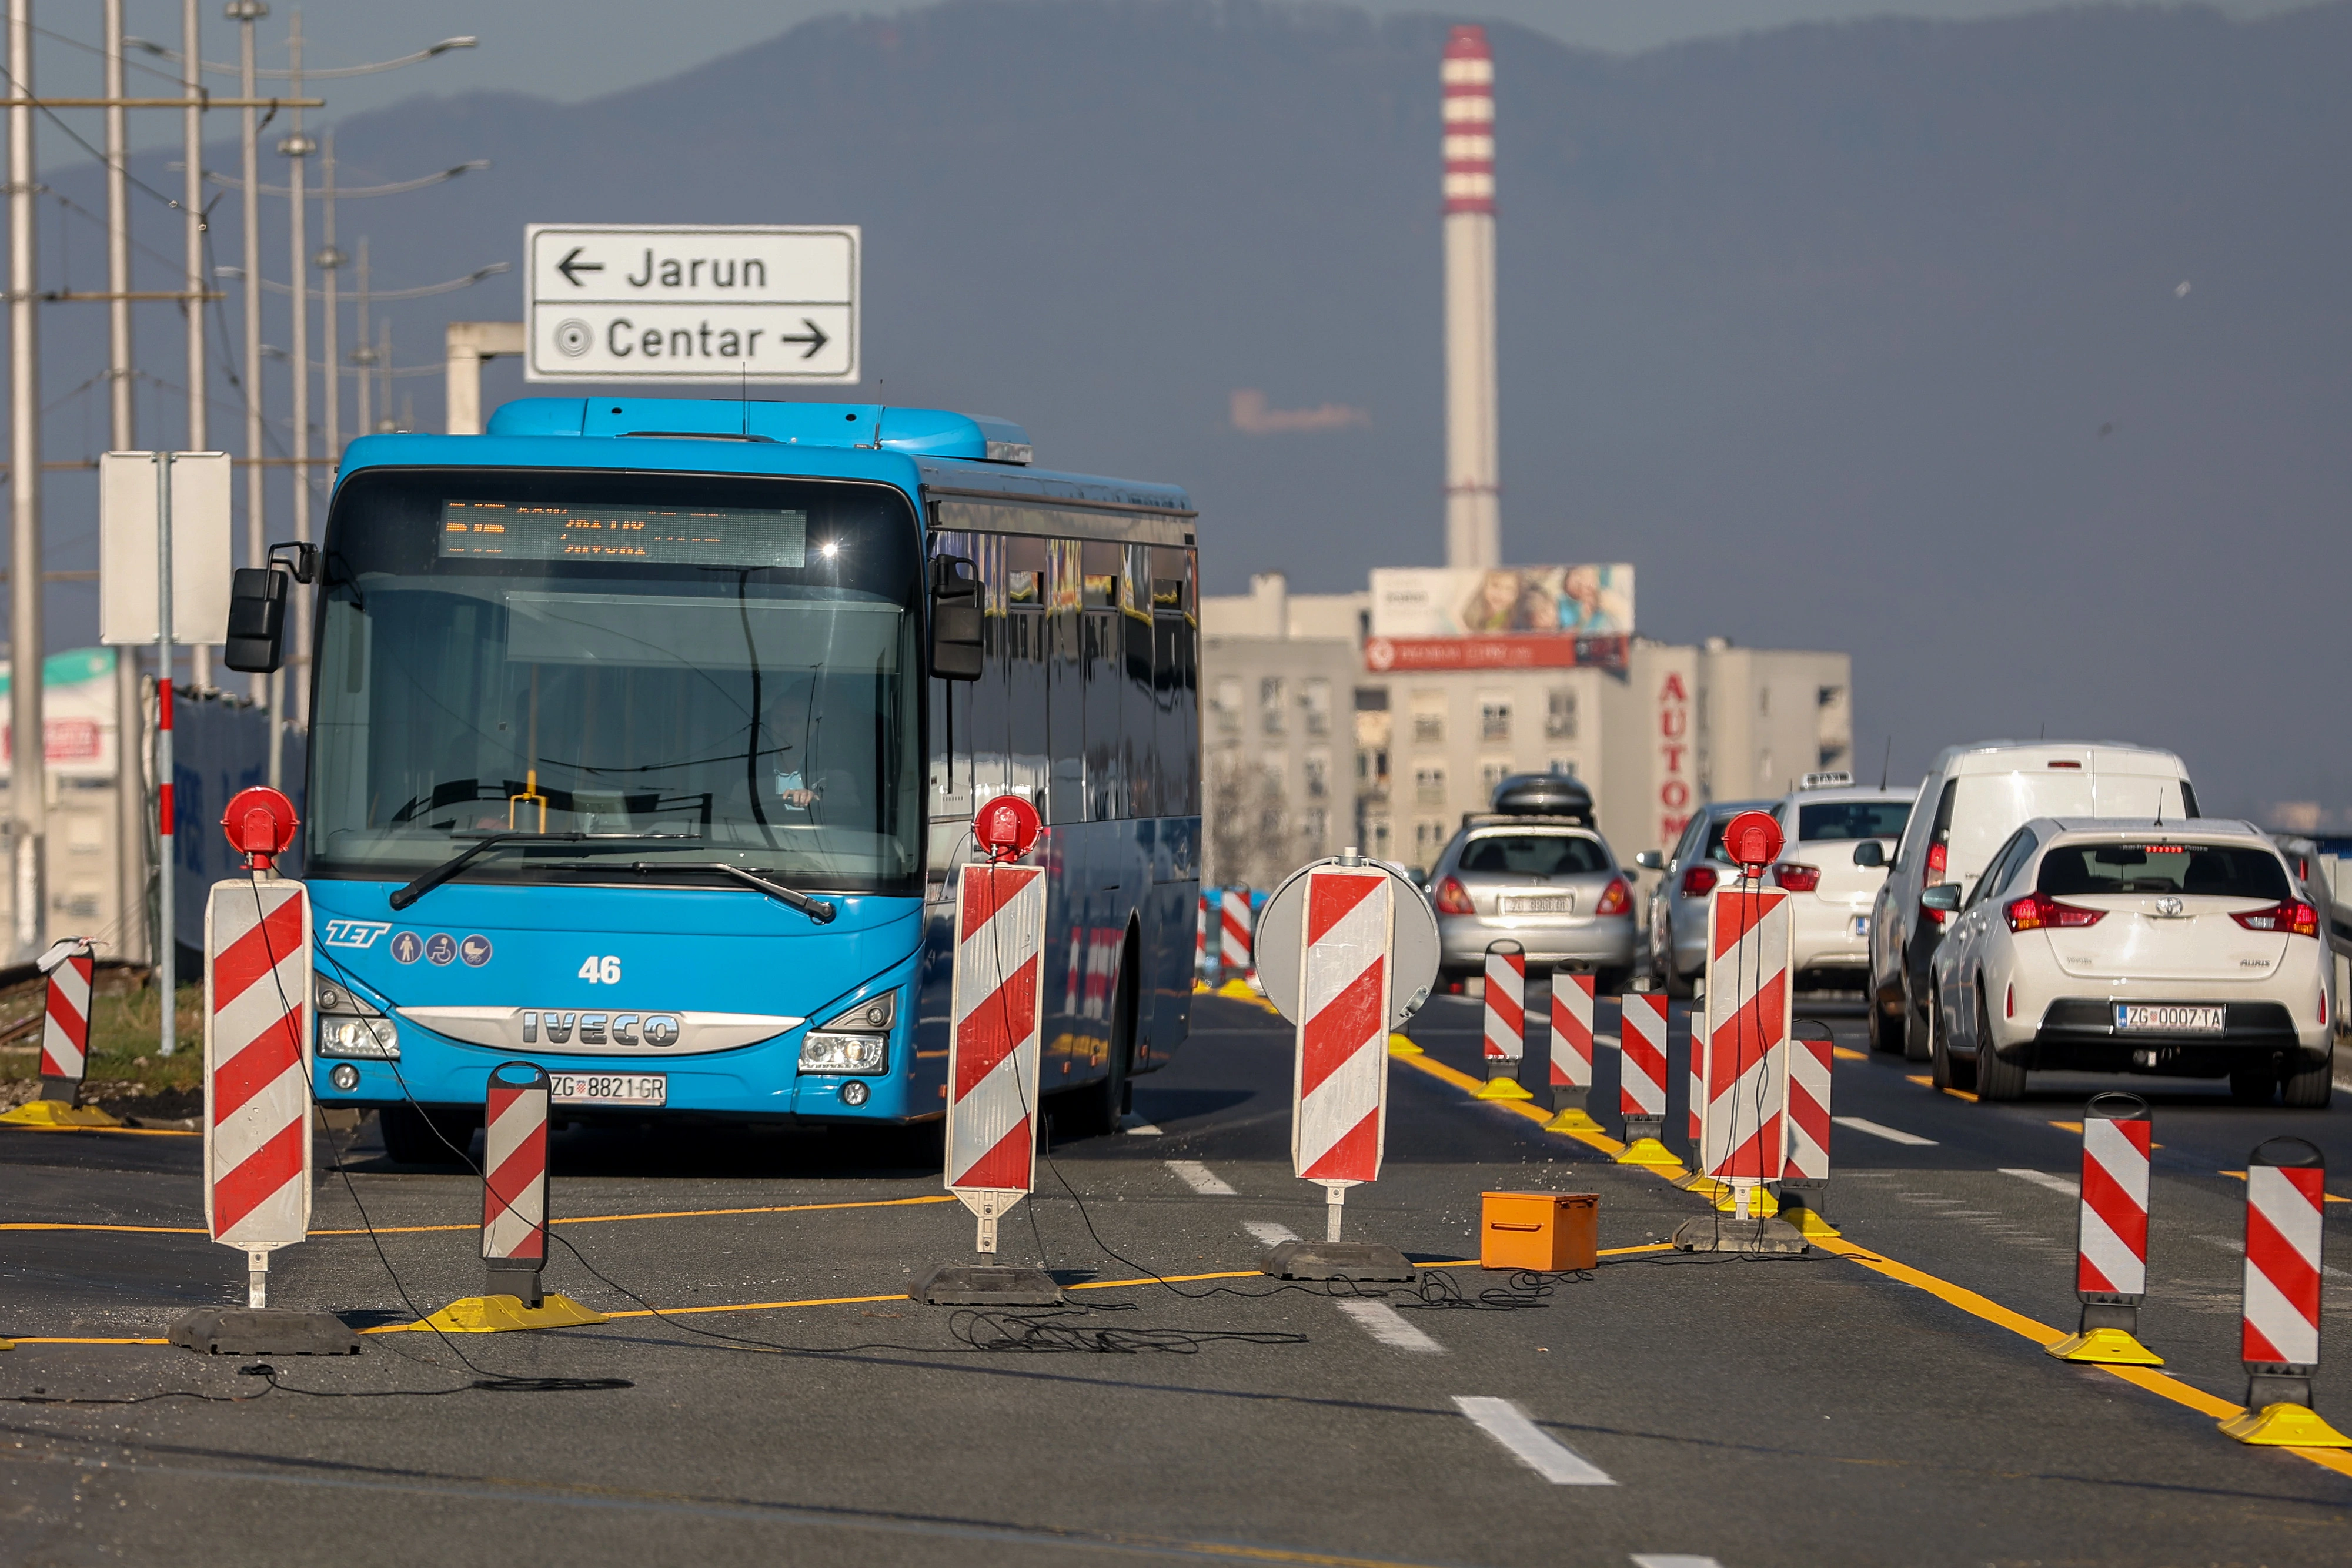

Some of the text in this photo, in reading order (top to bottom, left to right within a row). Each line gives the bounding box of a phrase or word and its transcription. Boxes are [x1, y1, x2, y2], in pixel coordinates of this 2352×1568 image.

[627, 246, 767, 288] Jarun
[607, 316, 766, 357] Centar
[1817, 773, 1841, 784] TAXI
[325, 919, 393, 949] ZET
[578, 956, 621, 984] 46
[523, 1012, 679, 1047] IVECO
[2129, 1007, 2148, 1024] ZG
[552, 1076, 574, 1096] ZG
